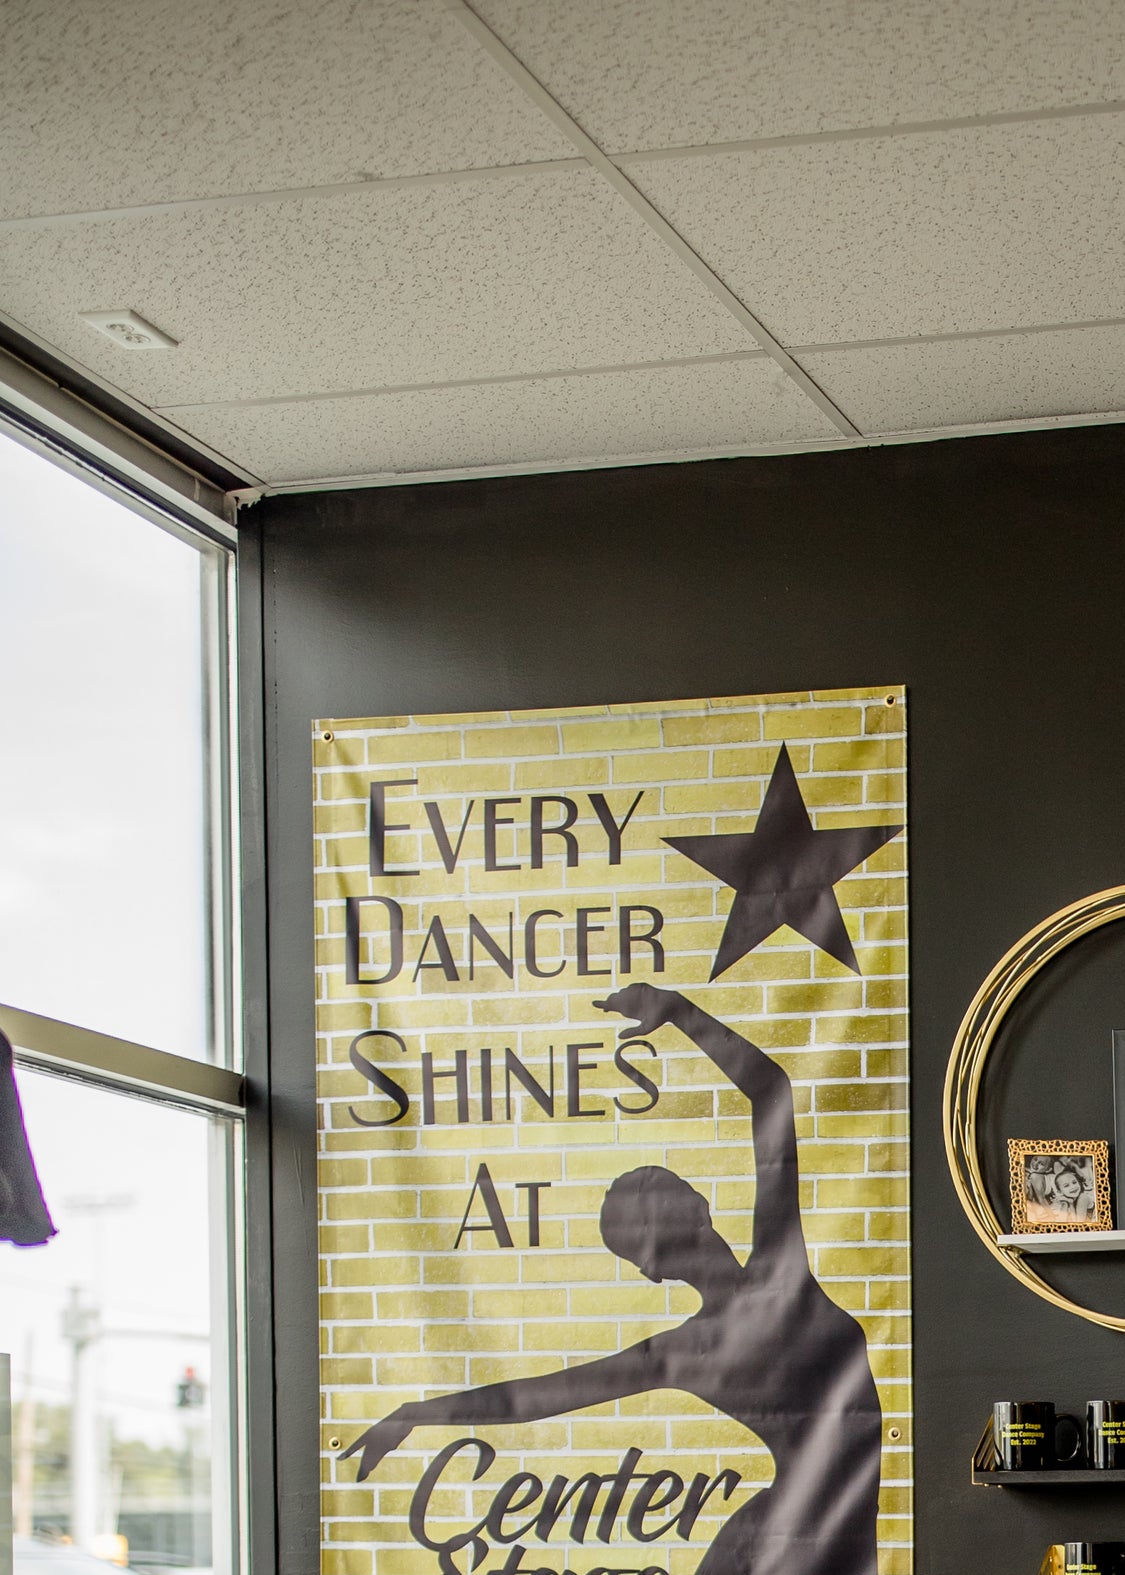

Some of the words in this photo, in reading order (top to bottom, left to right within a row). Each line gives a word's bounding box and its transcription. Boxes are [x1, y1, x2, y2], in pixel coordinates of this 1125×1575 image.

[369, 778, 645, 877] EVERY
[344, 895, 665, 985] DANCER
[348, 1030, 660, 1127] SHINES
[409, 1438, 741, 1552] Center
